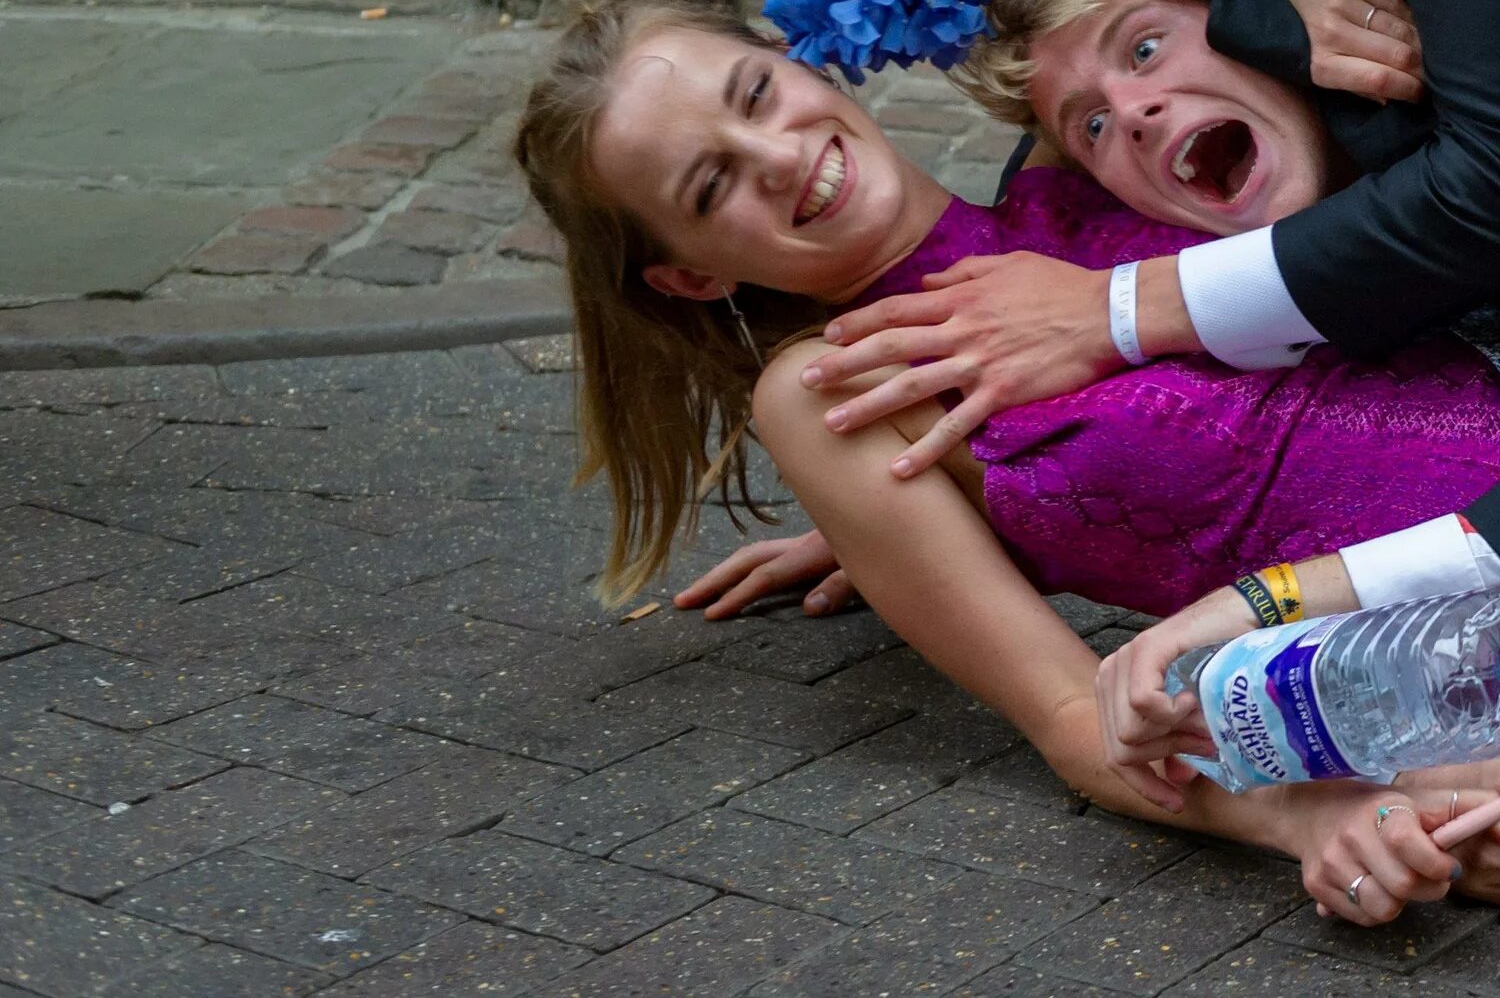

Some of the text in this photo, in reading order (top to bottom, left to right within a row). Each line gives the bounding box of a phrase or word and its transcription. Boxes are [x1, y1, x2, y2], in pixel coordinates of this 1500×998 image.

[1119, 289, 1129, 319] MAY
[1288, 667, 1302, 701] WATER
[1231, 675, 1287, 779] HIGHLAND
[1249, 703, 1280, 761] SPRING
[1294, 701, 1320, 753] SPRING
